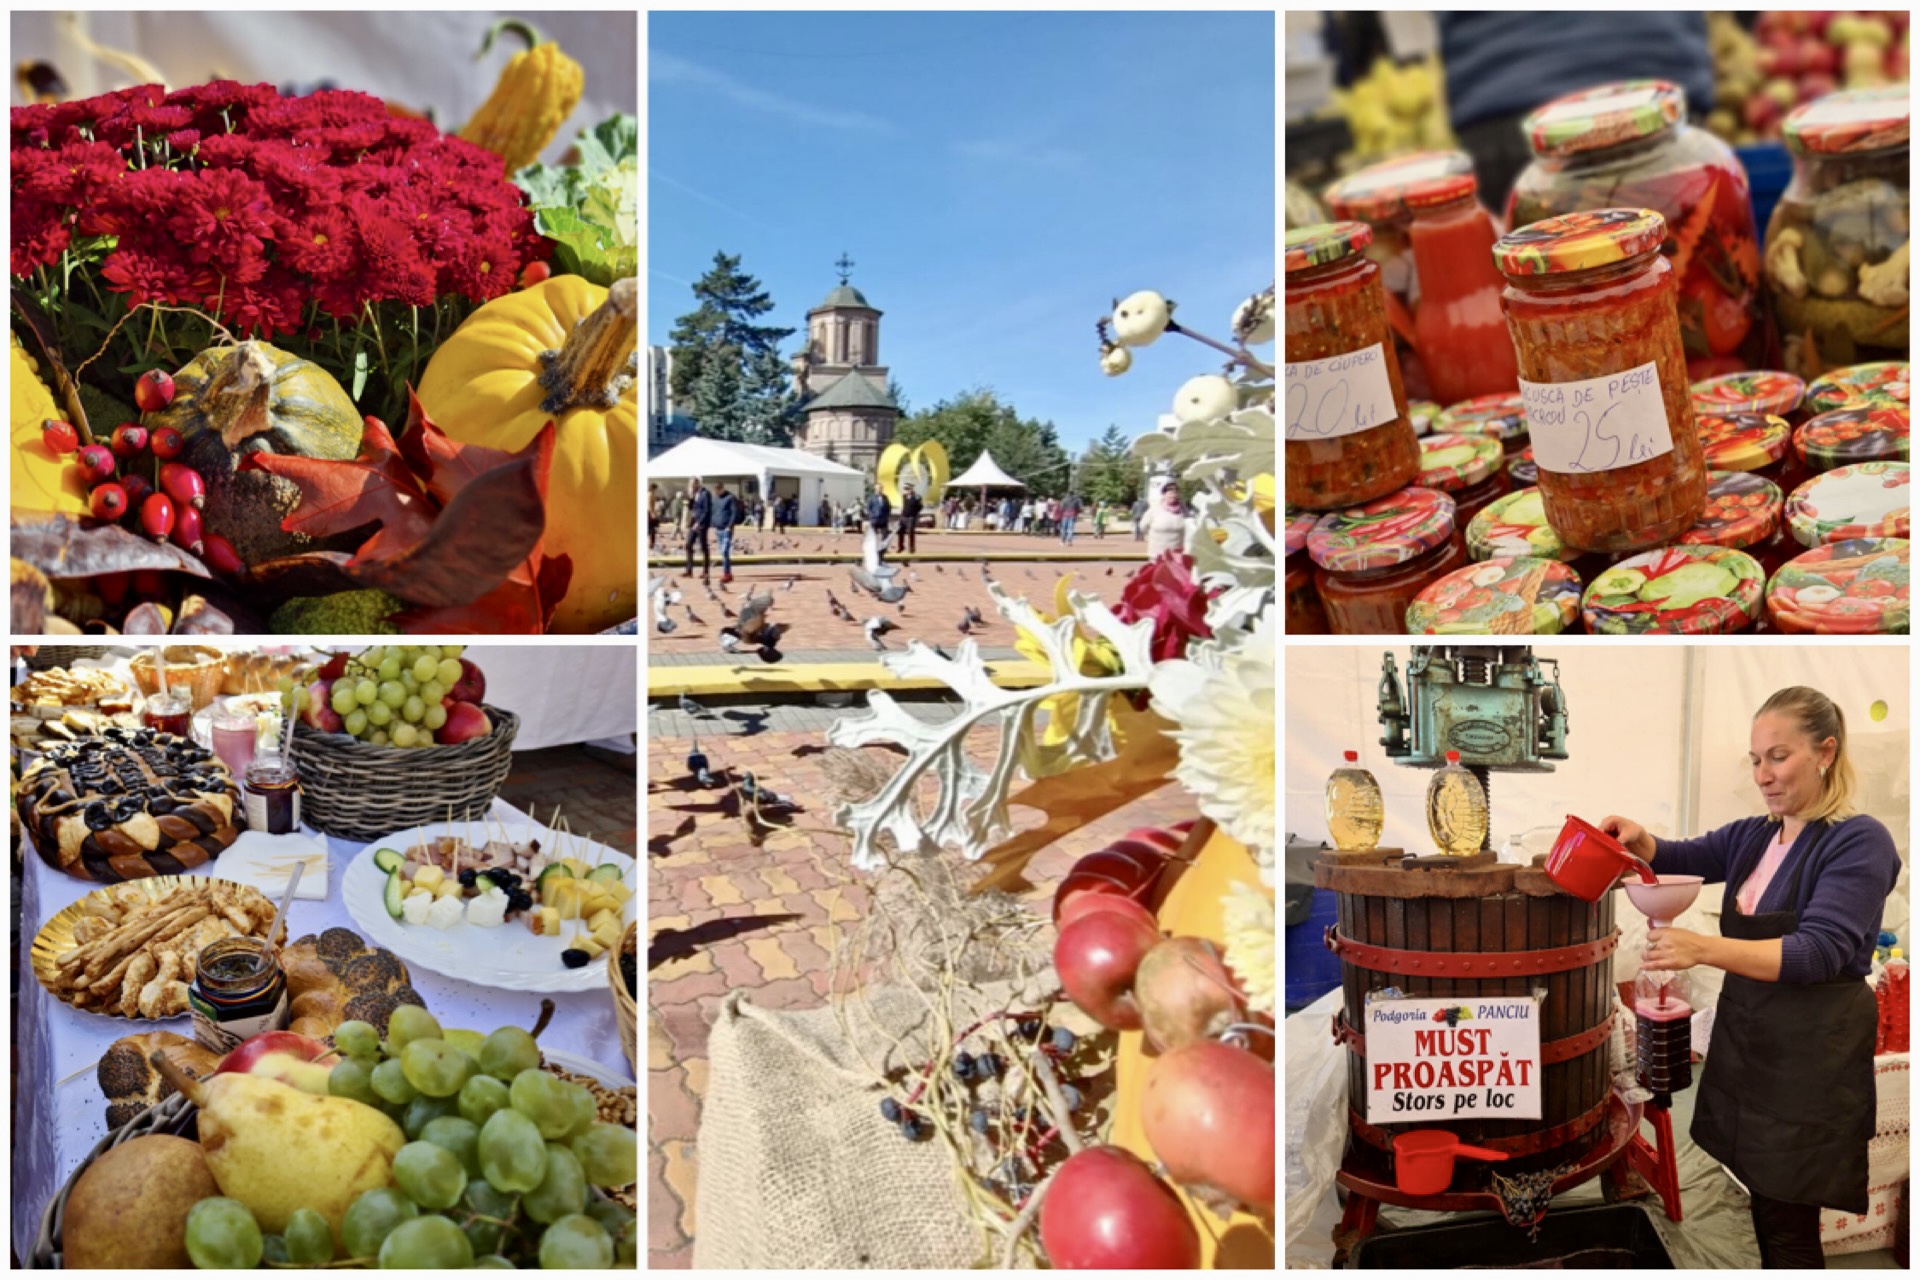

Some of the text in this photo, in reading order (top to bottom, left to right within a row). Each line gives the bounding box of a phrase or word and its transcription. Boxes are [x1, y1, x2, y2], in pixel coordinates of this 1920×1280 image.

[1304, 362, 1325, 379] DE
[1287, 379, 1348, 438] 20
[1572, 388, 1594, 408] DE
[1568, 401, 1654, 471] 25 lei
[1374, 1004, 1529, 1023] Podgoria PANCIU
[1415, 1028, 1492, 1057] MUST
[1374, 1051, 1533, 1090] PROASPĂT
[1393, 1088, 1514, 1113] Stors pe loc
